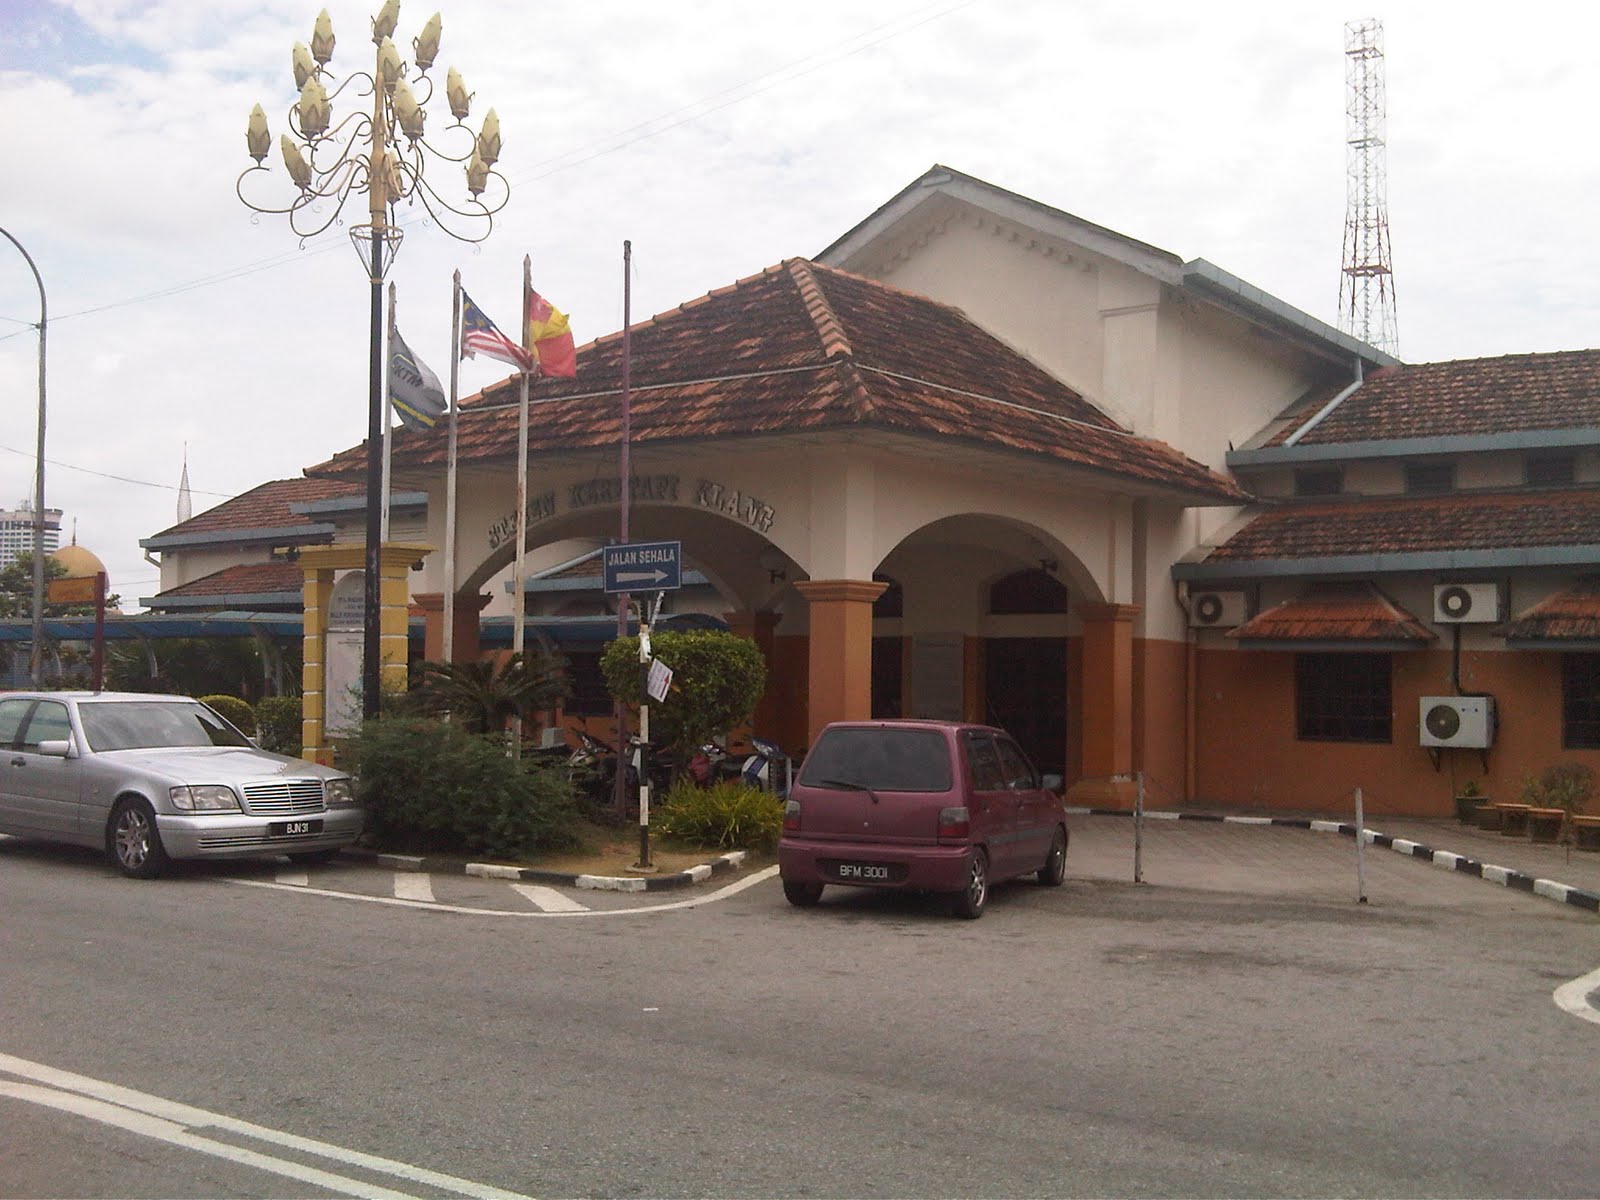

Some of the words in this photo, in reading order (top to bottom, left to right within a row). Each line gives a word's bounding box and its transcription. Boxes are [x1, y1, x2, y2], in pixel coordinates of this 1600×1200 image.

[696, 477, 776, 534] KLANG
[608, 551, 637, 566] JALAN
[639, 549, 675, 564] SEHALA
[840, 865, 861, 877] BFM
[863, 866, 888, 878] 3001
